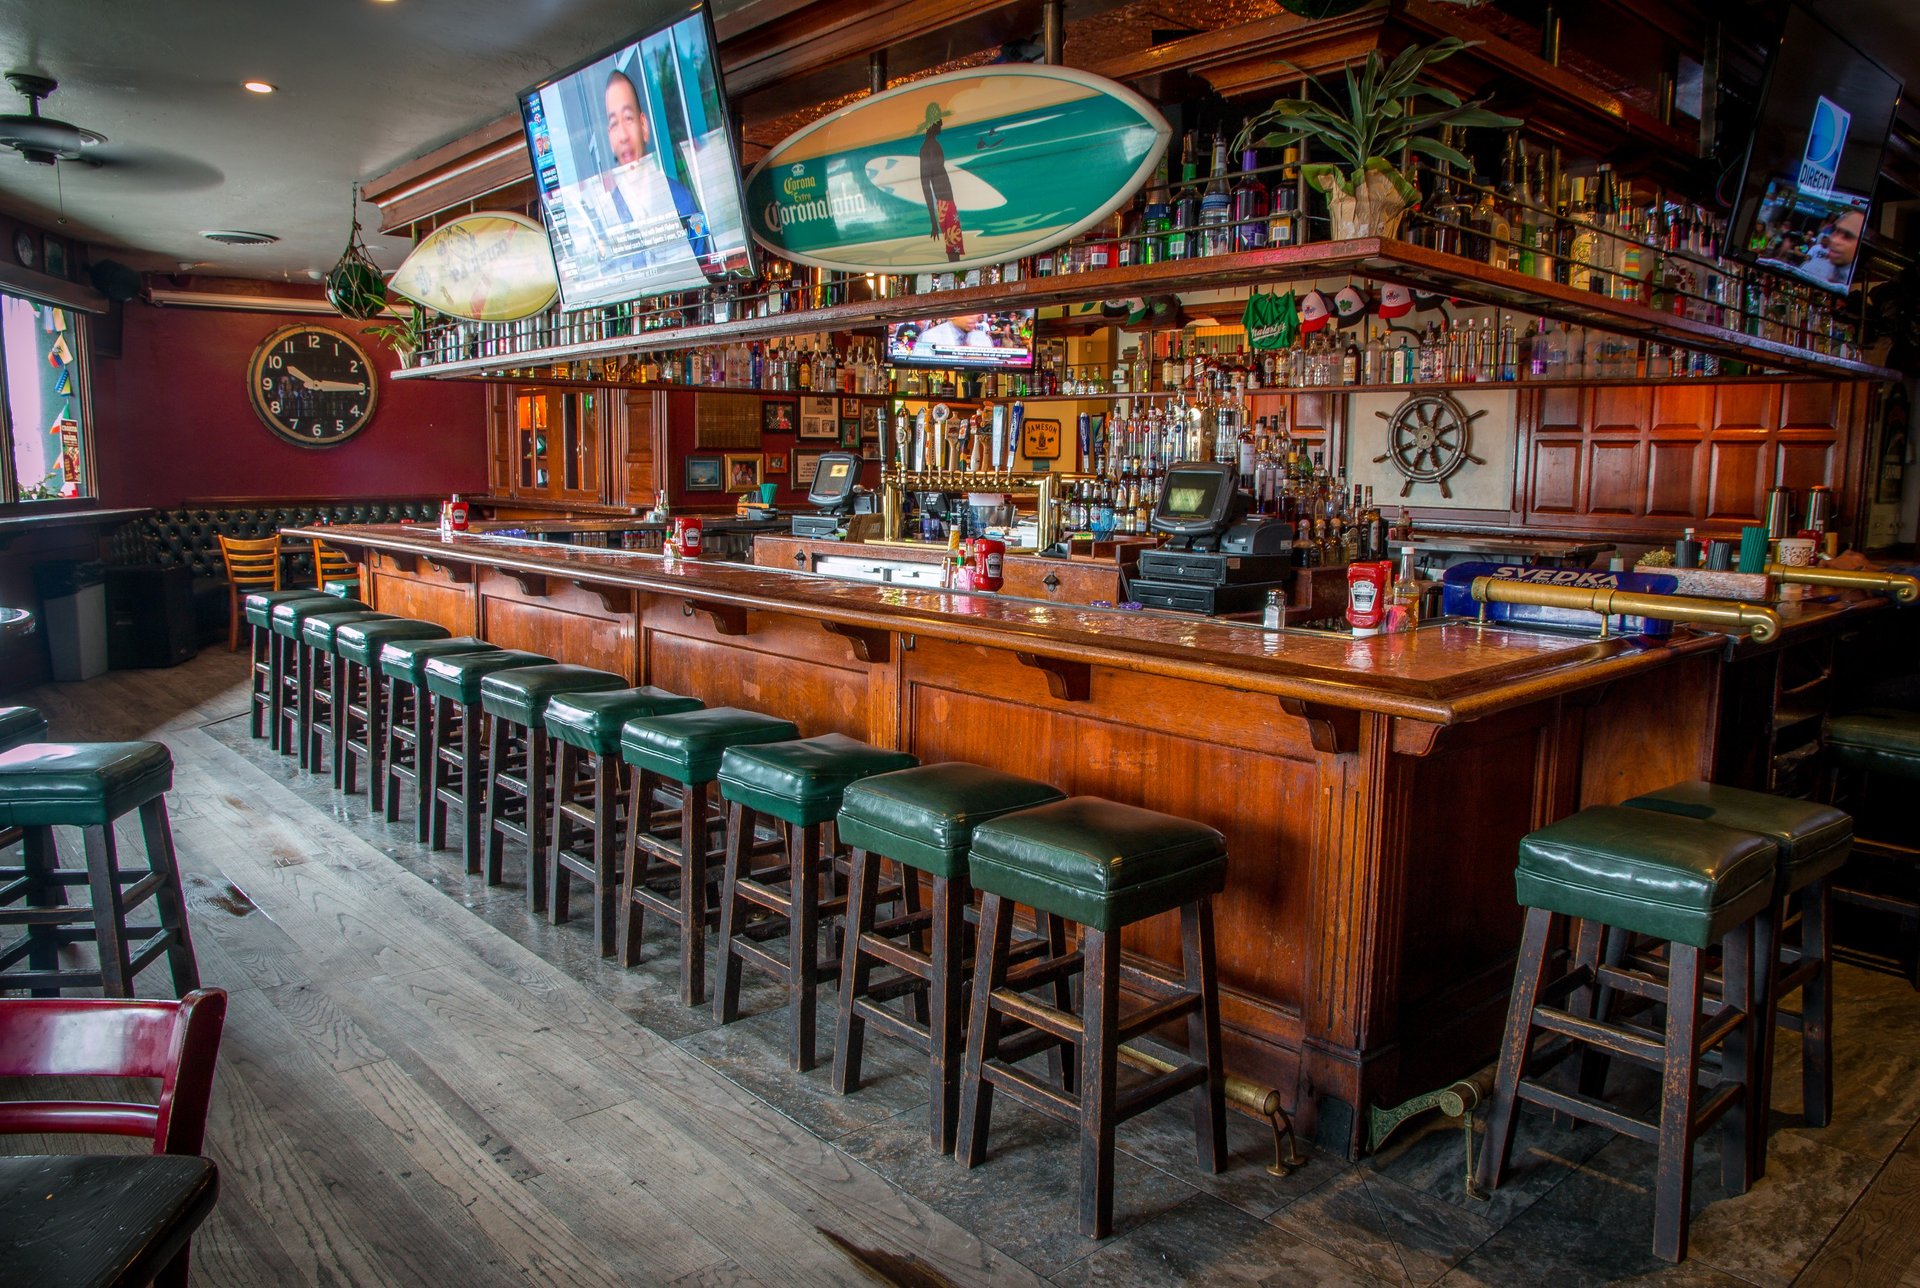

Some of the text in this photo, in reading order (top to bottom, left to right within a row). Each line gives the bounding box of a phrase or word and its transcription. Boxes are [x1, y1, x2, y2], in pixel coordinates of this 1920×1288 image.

[1800, 164, 1833, 190] DIRECTV
[783, 175, 816, 195] Corona
[284, 341, 294, 354] 11
[308, 335, 321, 348] 12
[268, 355, 283, 369] 10
[350, 360, 358, 373] 2
[262, 377, 273, 391] 9
[270, 401, 281, 414] 8
[349, 405, 361, 417] 4
[289, 418, 299, 430] 7
[312, 424, 322, 437] 6
[336, 419, 344, 431] 5
[1027, 423, 1058, 434] JAMESON
[1491, 566, 1619, 586] SVEDKA
